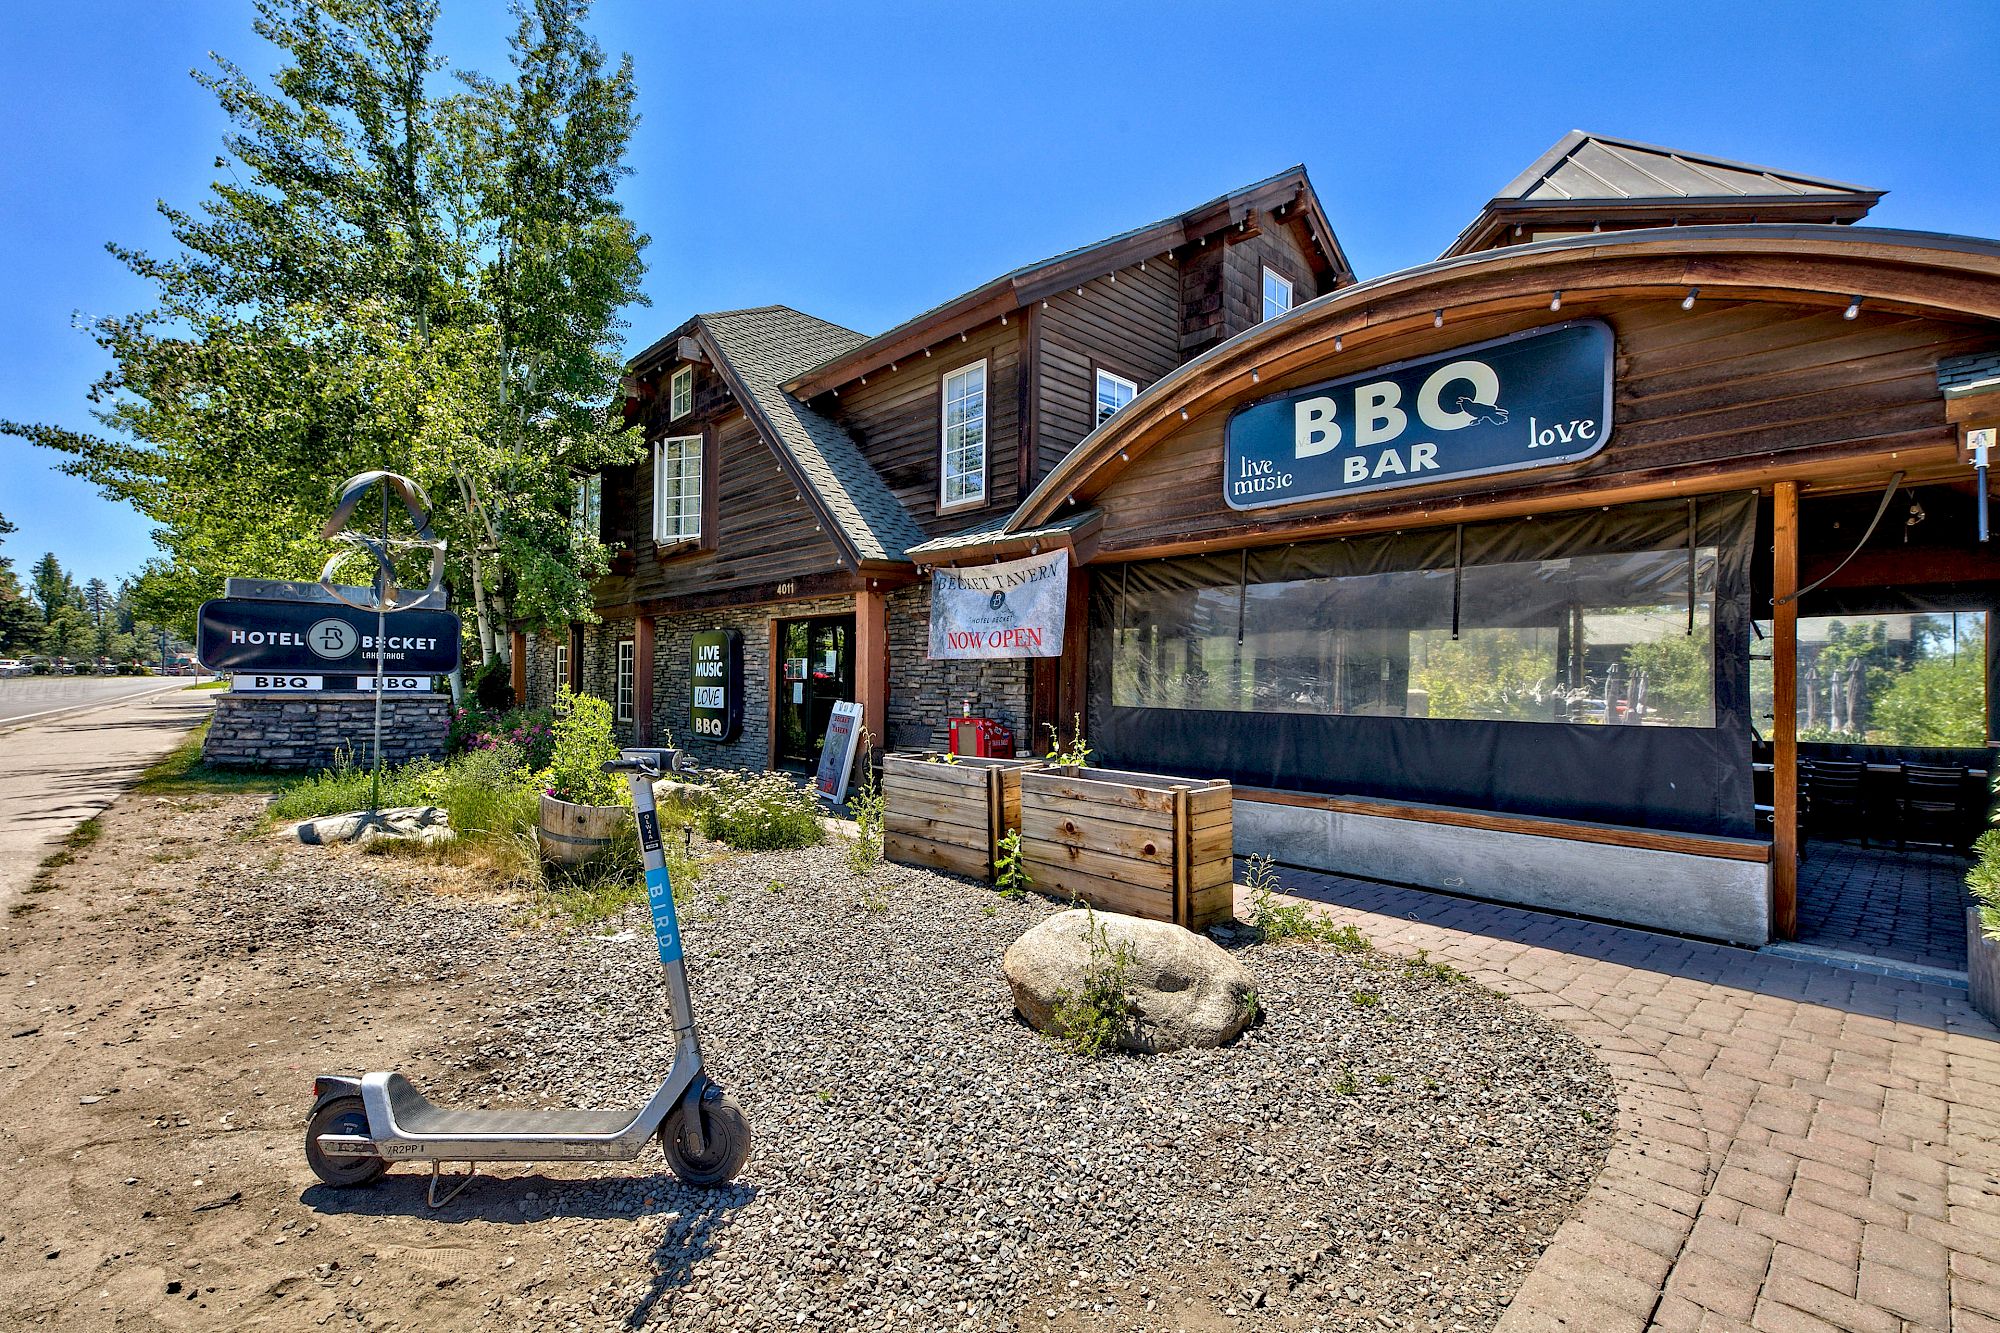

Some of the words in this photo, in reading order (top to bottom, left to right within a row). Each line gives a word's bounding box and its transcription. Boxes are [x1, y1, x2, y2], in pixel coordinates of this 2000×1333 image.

[1293, 360, 1508, 460] BBQ
[1527, 415, 1596, 449] love
[1240, 455, 1273, 478] live
[1343, 442, 1441, 484] BAR
[1234, 471, 1293, 496] music
[937, 576, 991, 591] BECKET
[992, 561, 1059, 588] TAVERN
[776, 582, 794, 595] 4011
[231, 630, 304, 646] HOTEL
[362, 635, 437, 650] BECKET
[947, 631, 986, 650] NOW
[988, 627, 1042, 649] OPEN
[698, 645, 720, 660] LIVE
[695, 661, 723, 677] MUSIC
[254, 676, 308, 689] BBQ
[697, 688, 720, 706] LOVE
[695, 717, 722, 736] BBQ
[650, 882, 673, 948] BIRD
